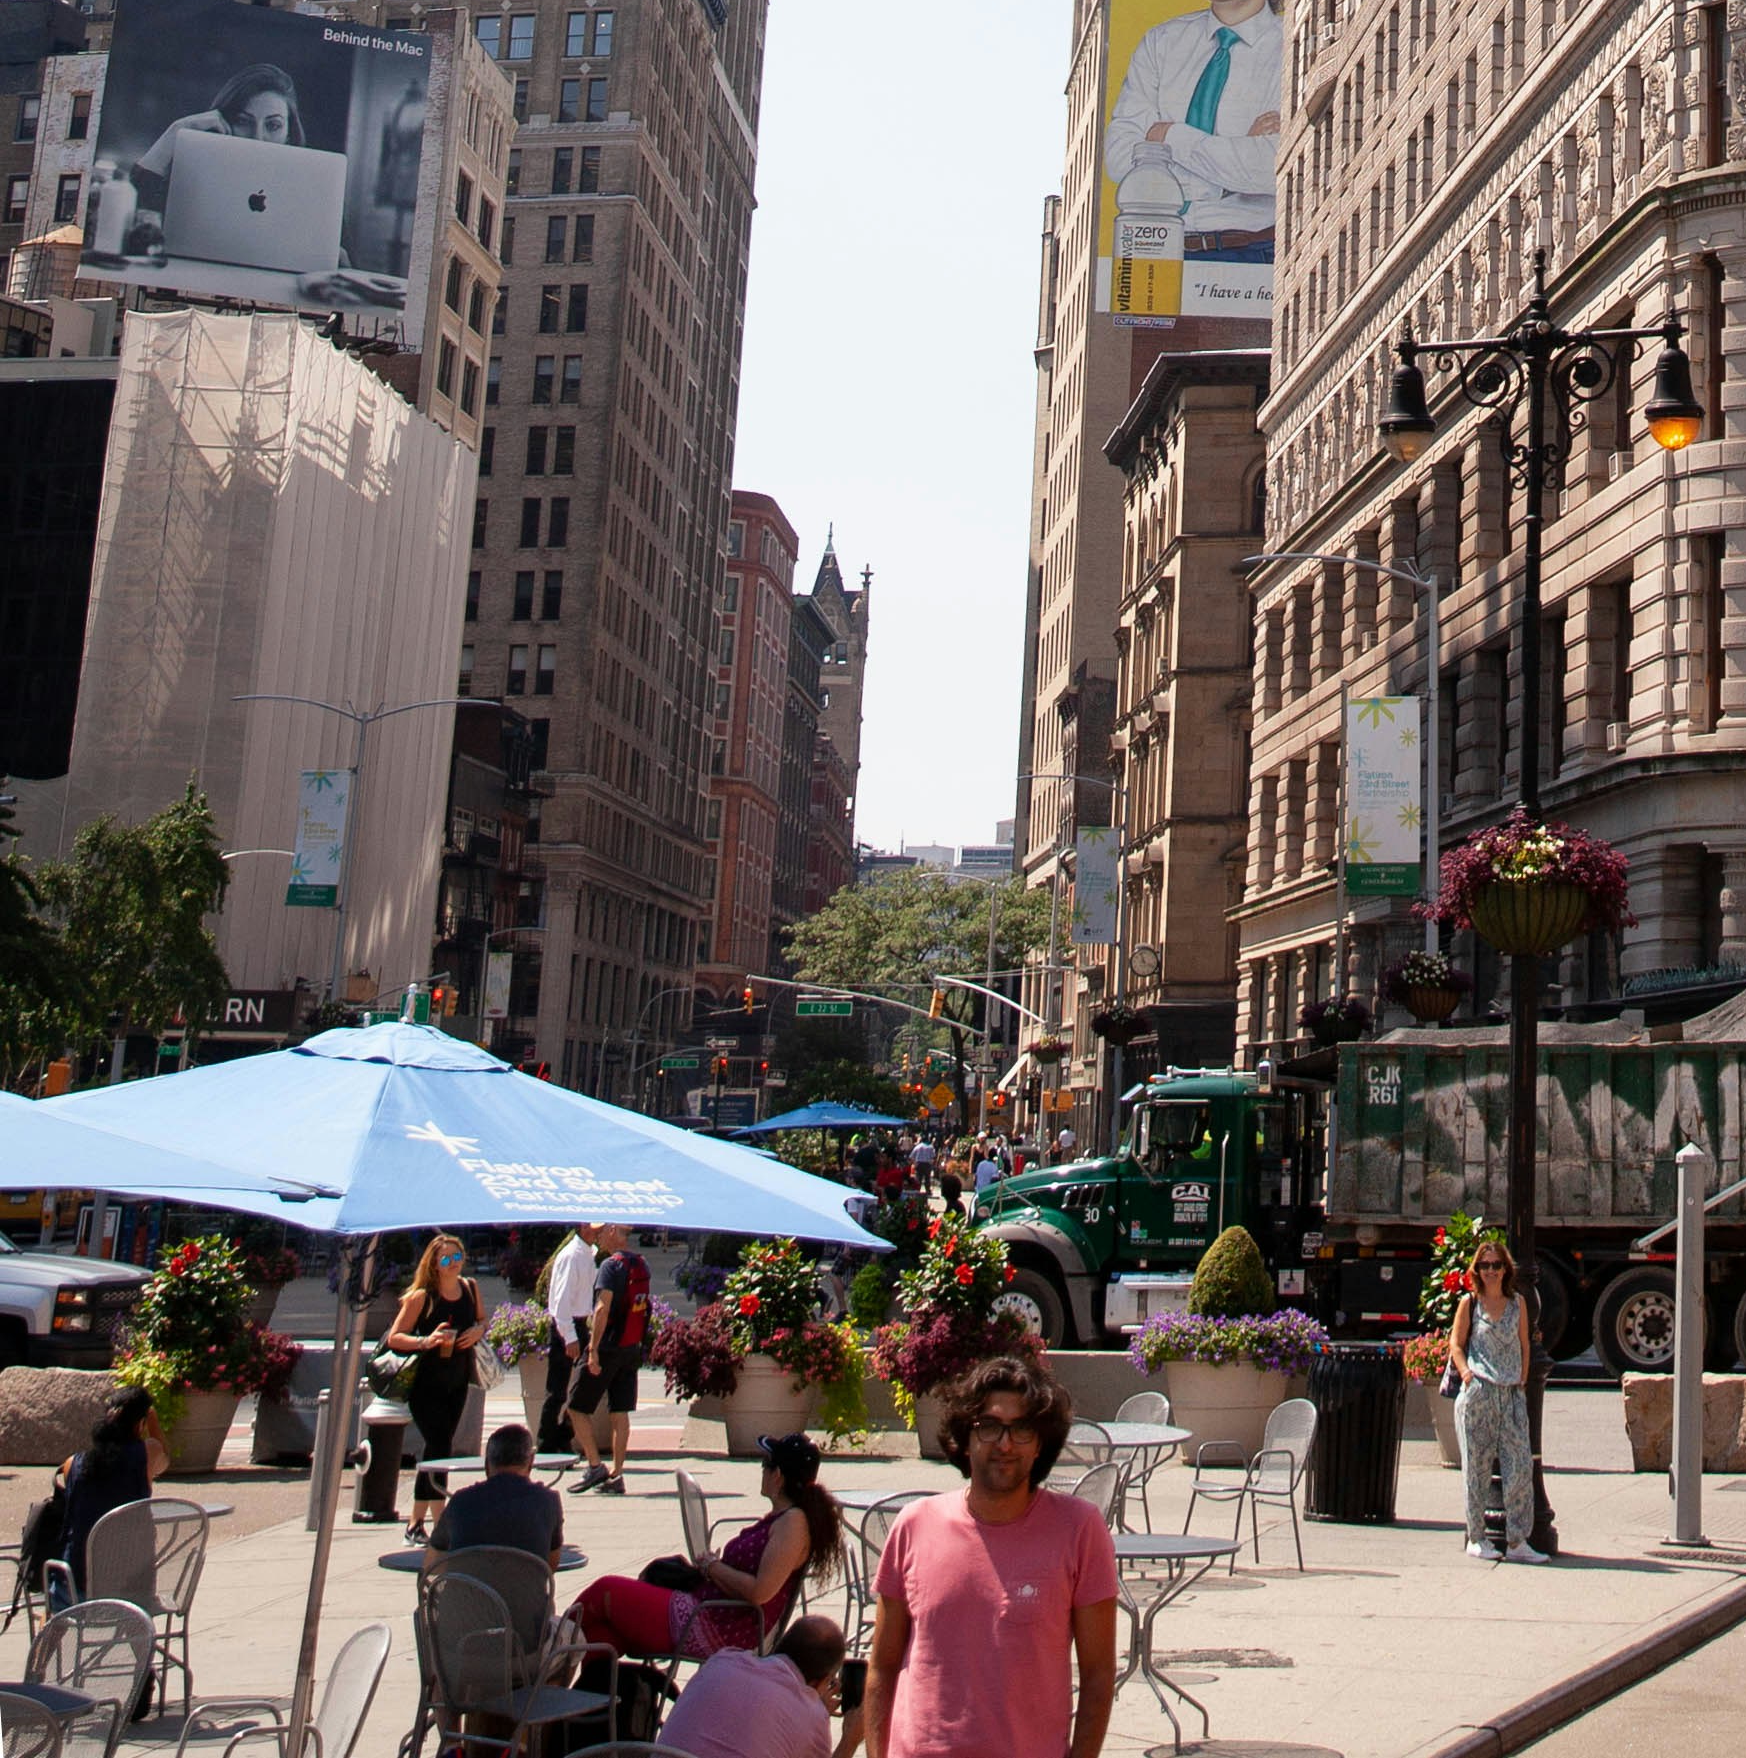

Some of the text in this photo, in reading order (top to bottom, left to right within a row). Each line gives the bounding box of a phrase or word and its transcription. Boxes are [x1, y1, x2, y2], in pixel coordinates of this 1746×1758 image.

[323, 28, 424, 56] Behind the Mac
[1134, 225, 1168, 239] zero
[1209, 284, 1241, 300] have
[1244, 291, 1252, 300] a
[458, 1158, 594, 1178] Flatiron
[475, 1173, 673, 1192] 23rd Street
[486, 1186, 684, 1207] Partnership
[1083, 1207, 1100, 1223] 30
